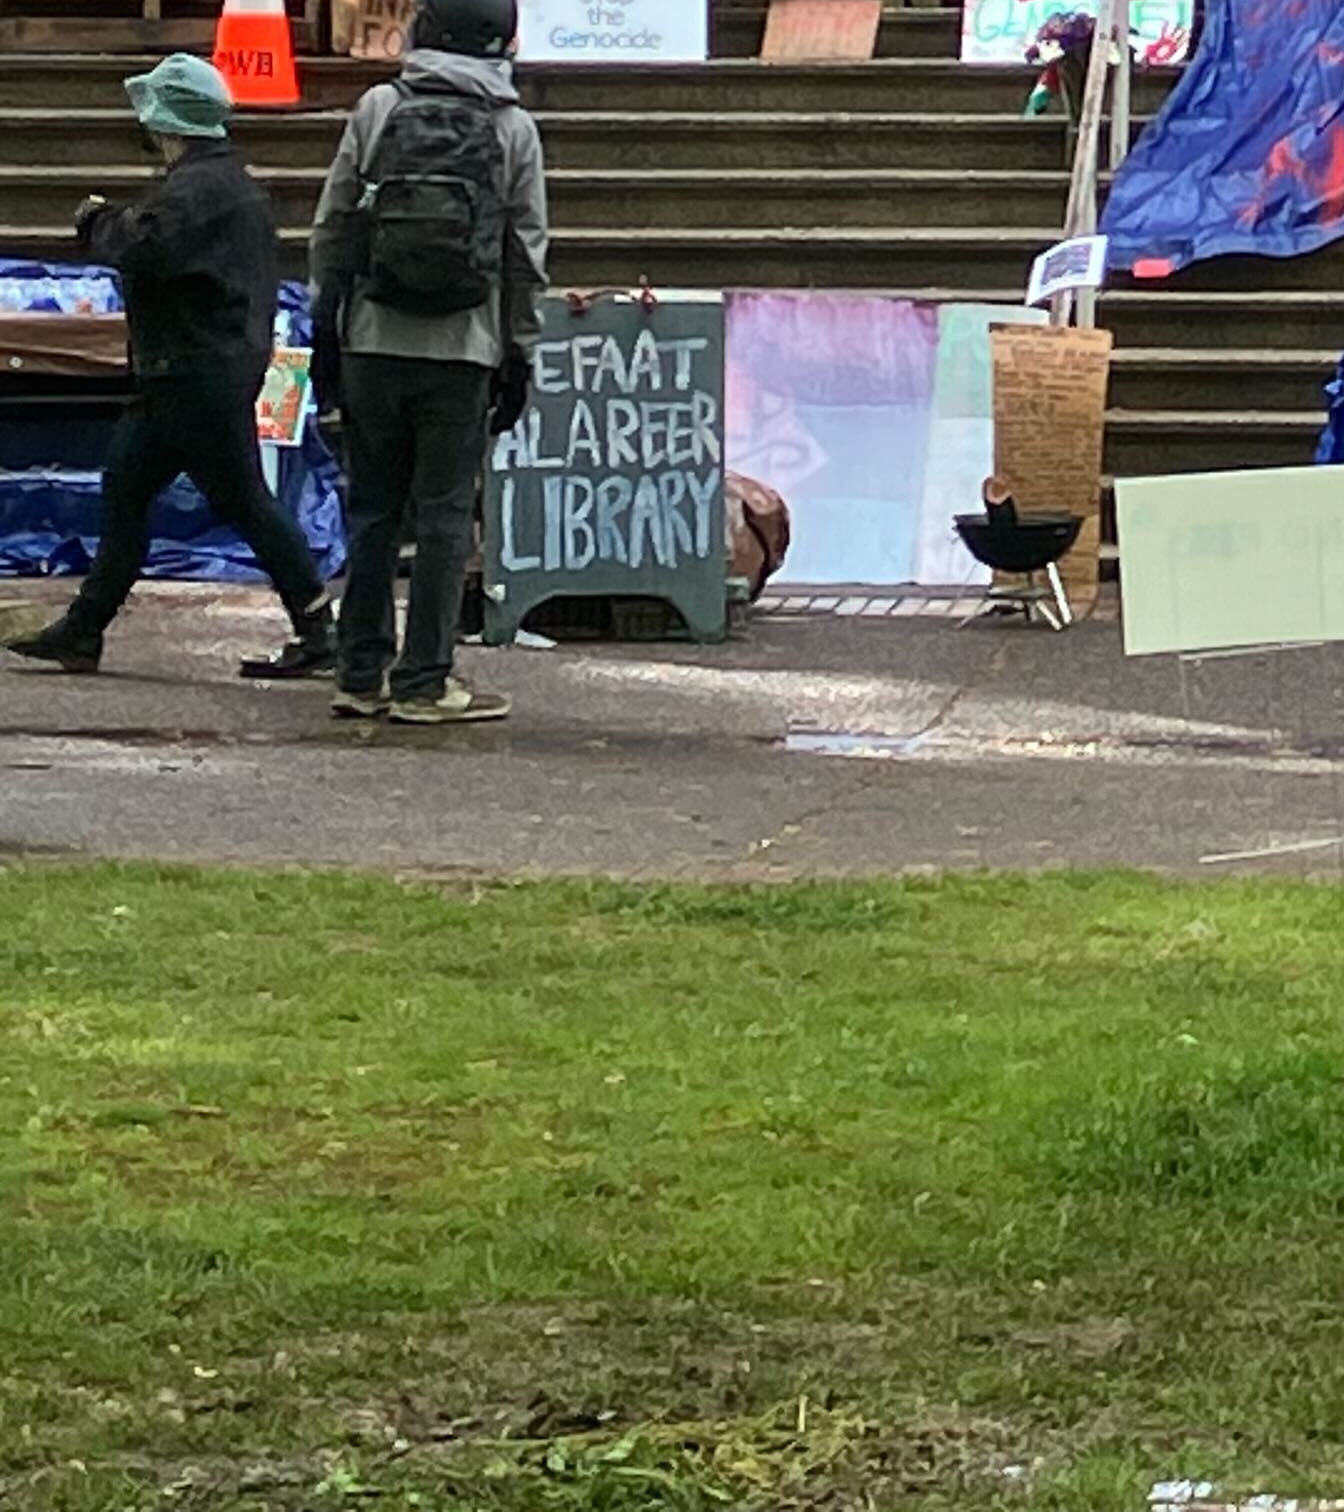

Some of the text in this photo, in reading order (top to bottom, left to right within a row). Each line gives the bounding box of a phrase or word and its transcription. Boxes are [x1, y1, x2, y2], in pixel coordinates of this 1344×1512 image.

[550, 26, 663, 50] Genocide
[587, 6, 626, 26] the
[492, 398, 721, 472] ALAREER
[500, 469, 720, 573] LIBRARY
